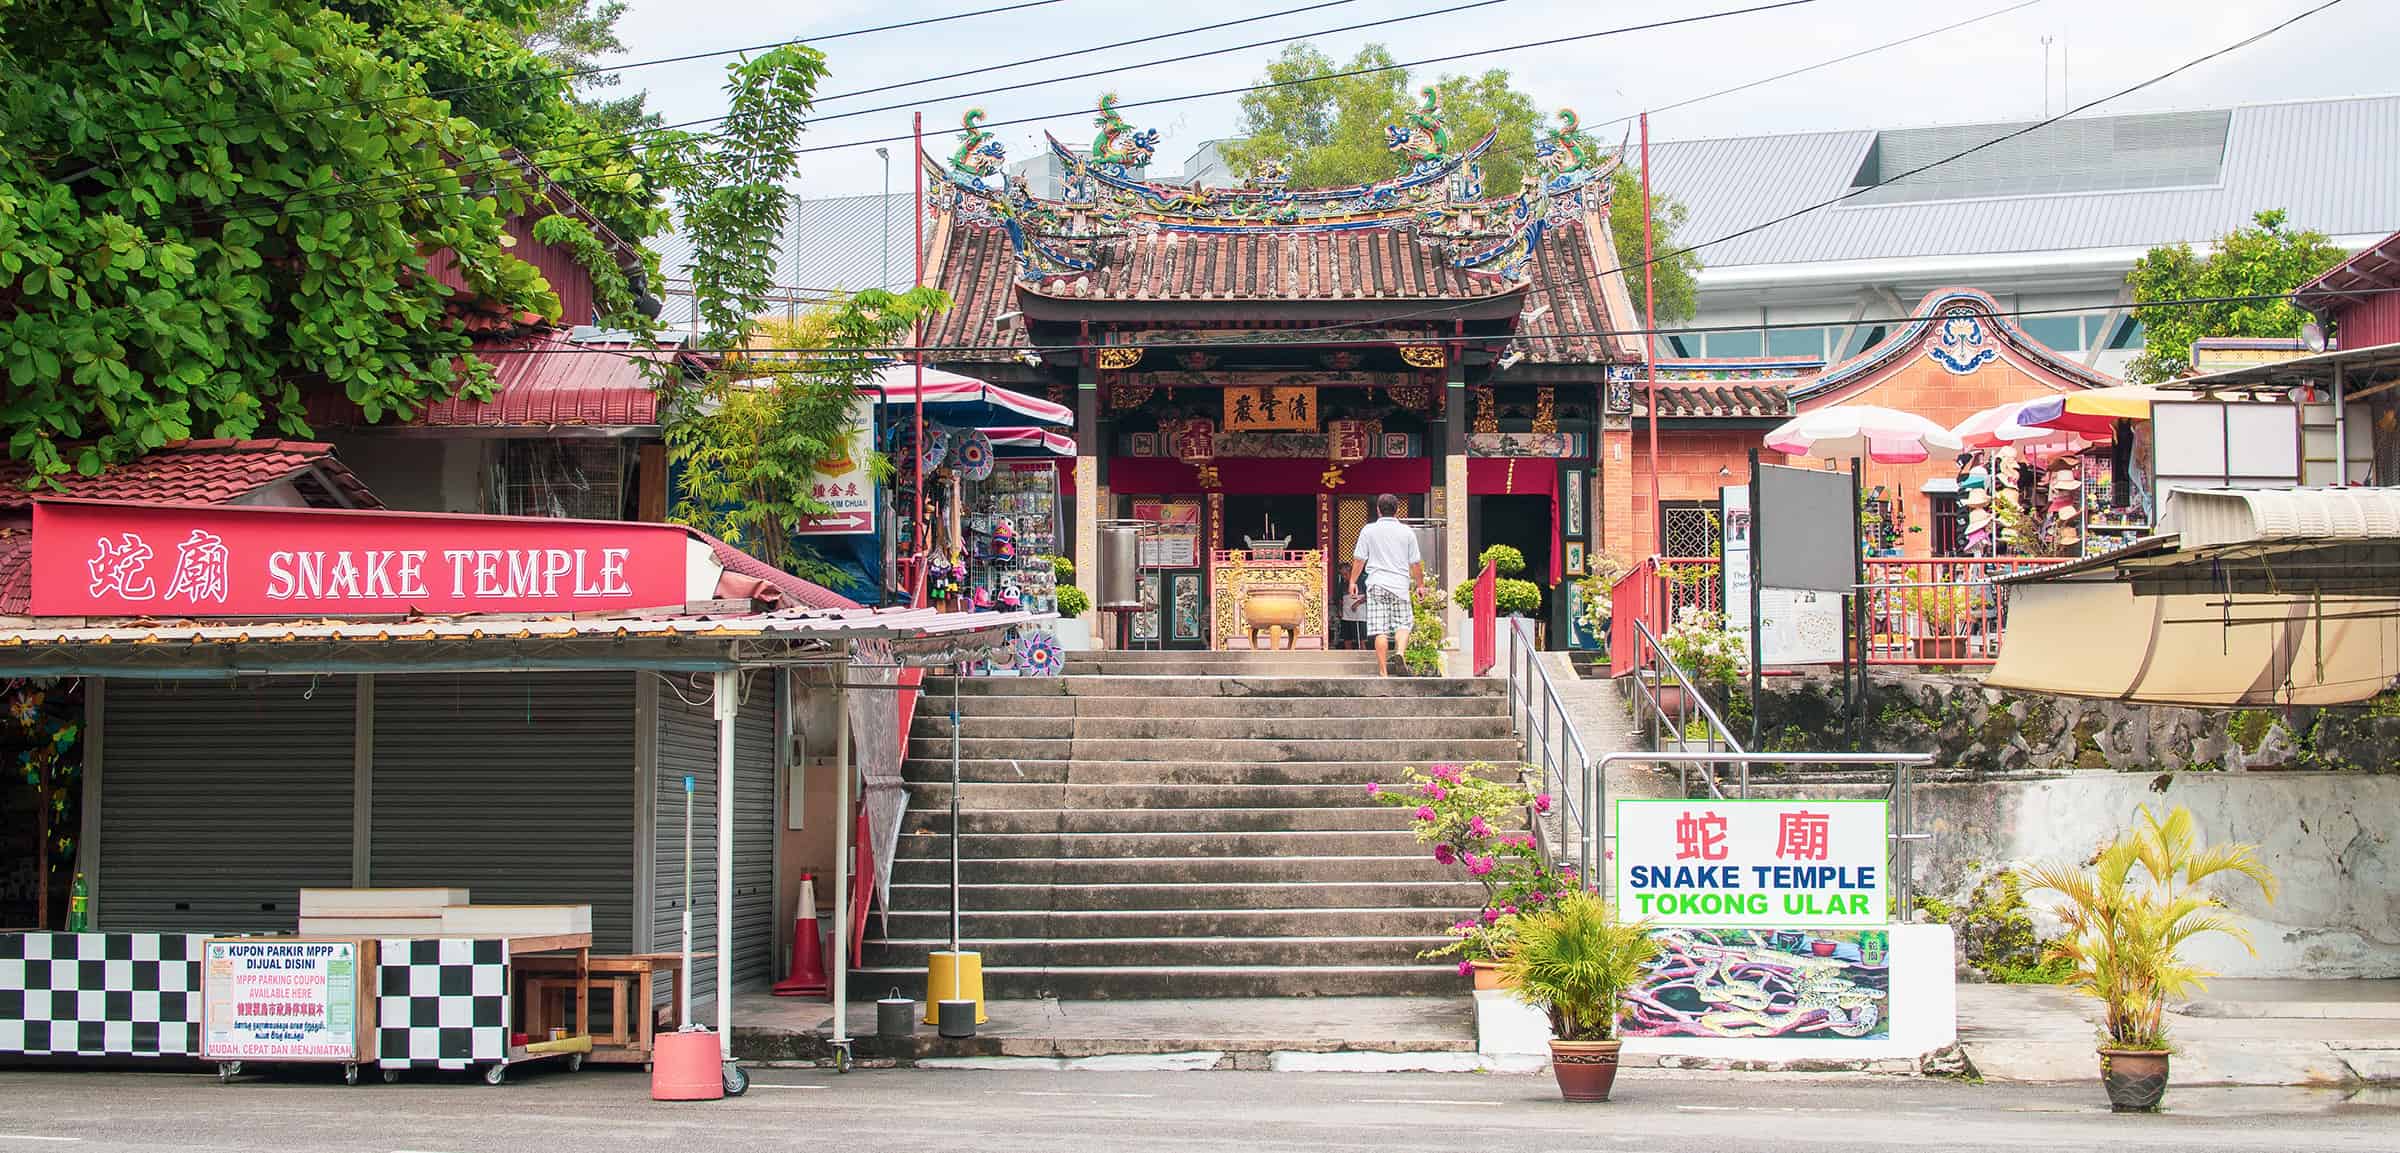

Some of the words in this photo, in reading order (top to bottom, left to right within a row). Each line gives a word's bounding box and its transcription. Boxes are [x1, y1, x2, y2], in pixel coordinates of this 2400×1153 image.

[88, 529, 229, 603] 蛇廟
[267, 550, 429, 599] SNAKE
[443, 548, 632, 599] TEMPLE
[1630, 865, 1740, 889] SNAKE
[1752, 865, 1875, 889] TEMPLE
[1635, 893, 1768, 915] TOKONG
[1784, 893, 1870, 915] ULAR
[229, 946, 264, 957] KUPON
[267, 945, 304, 957] PARKIR
[306, 945, 334, 957] MPPP
[246, 959, 282, 969] DIJUAL
[285, 959, 316, 969] DISINI
[236, 975, 257, 985] MPPP
[258, 975, 292, 985] PARKING
[294, 975, 325, 985] COUPON
[249, 988, 289, 998] AVAILABLE
[292, 988, 312, 998] HERE
[243, 1044, 269, 1055] CEPAT
[271, 1044, 288, 1055] DAN
[291, 1044, 352, 1055] MENJIMATKAN
